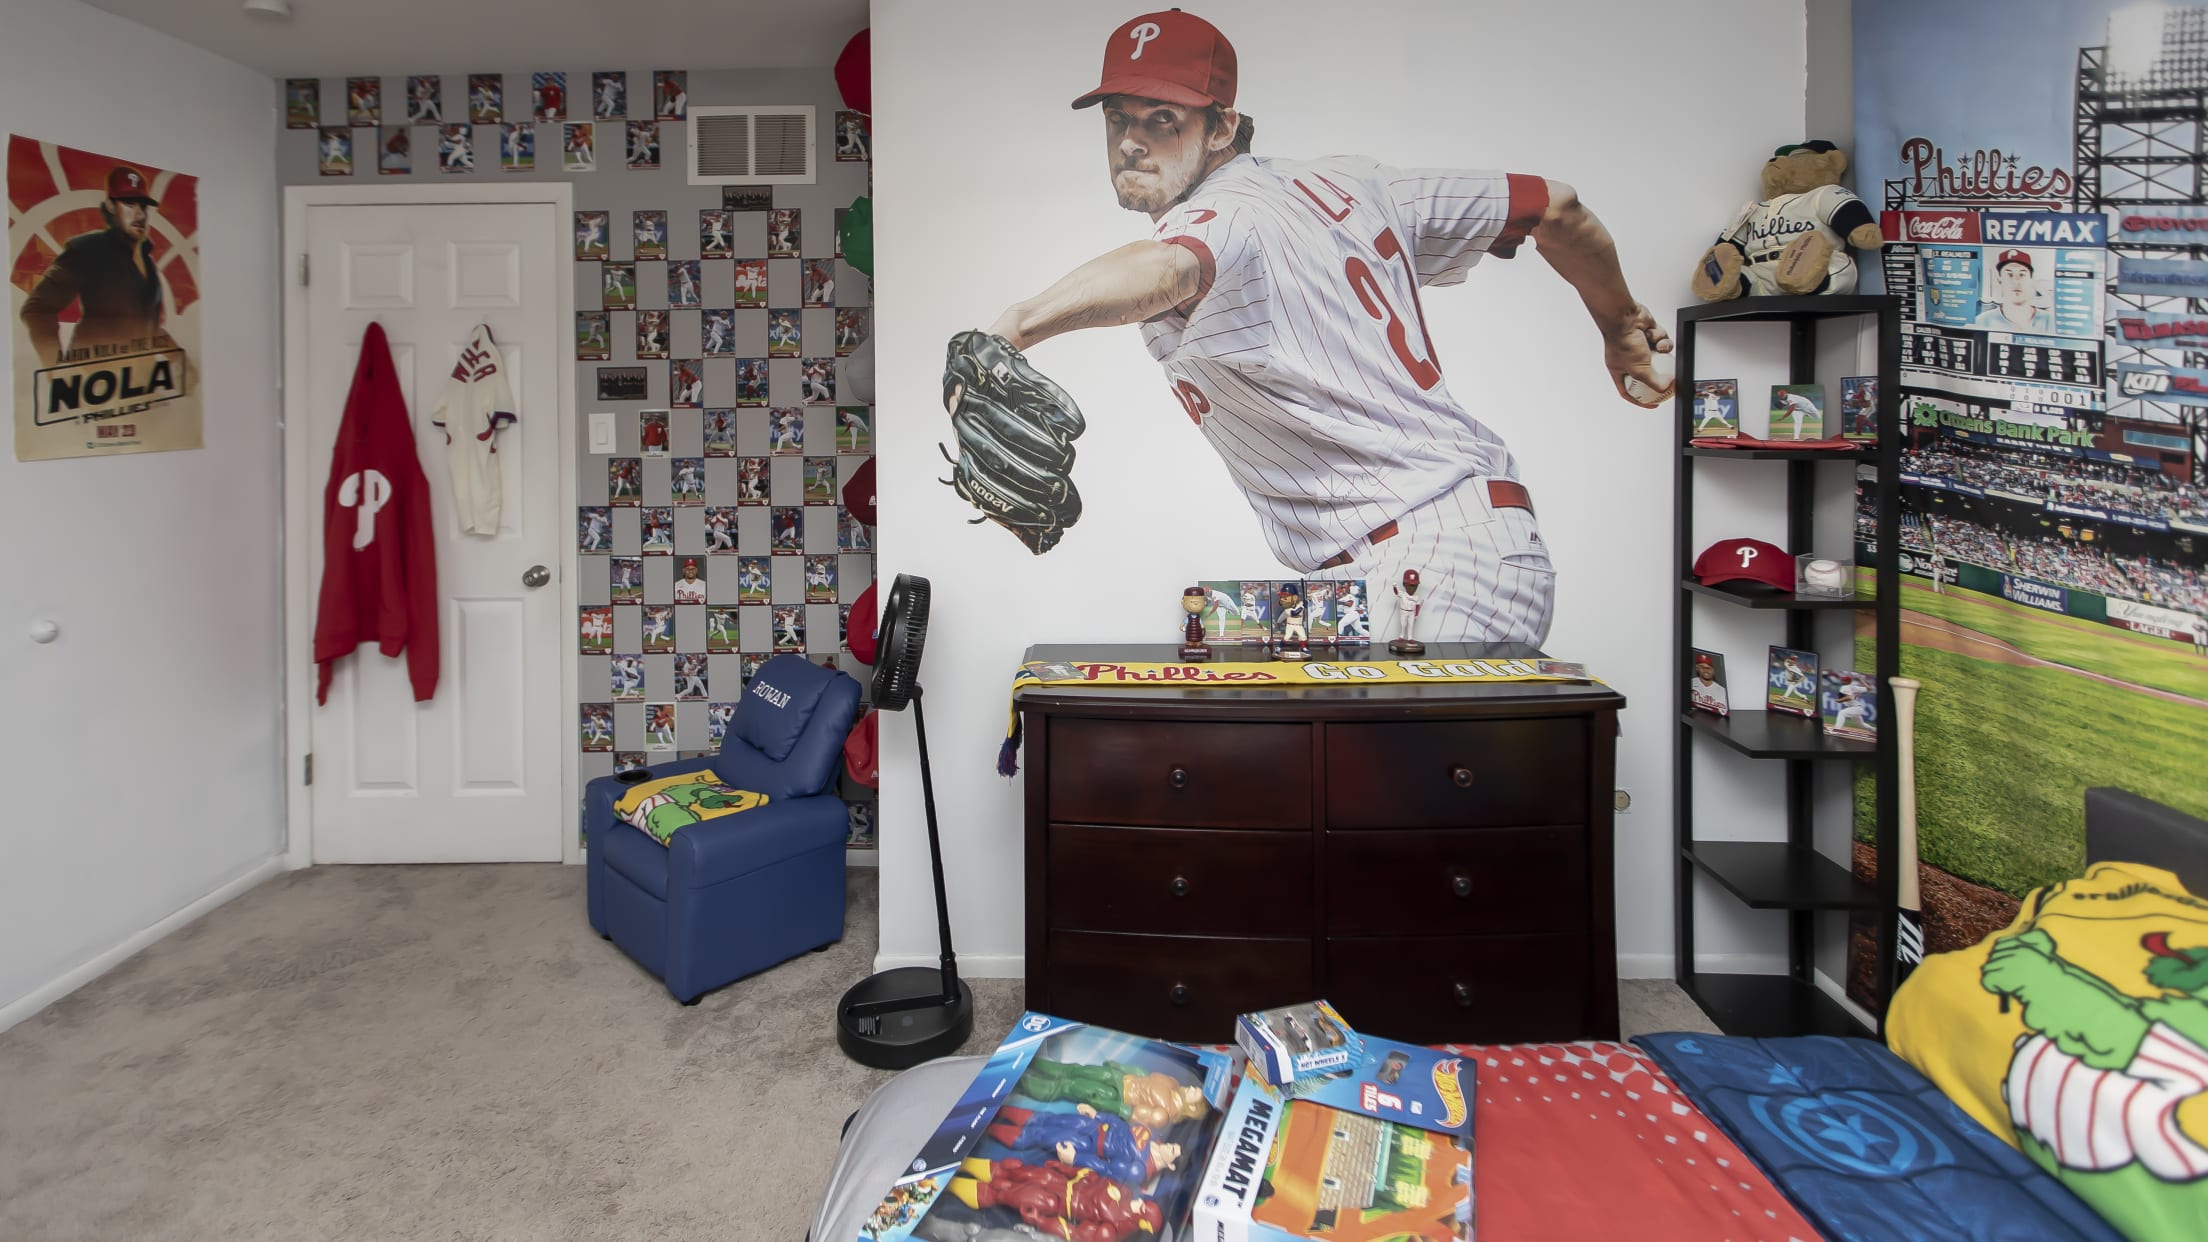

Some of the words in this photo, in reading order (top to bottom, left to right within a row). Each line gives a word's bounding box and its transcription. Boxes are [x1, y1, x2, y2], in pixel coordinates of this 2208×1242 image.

[1130, 22, 1161, 59] P
[1901, 137, 2072, 196] Phillies
[1747, 216, 1816, 241] Phillies
[1985, 219, 2096, 243] RE/MAX
[48, 360, 175, 414] NOLA
[1939, 411, 1993, 435] Citizens
[1995, 419, 2044, 441] Bank
[2047, 425, 2095, 448] Park
[338, 469, 392, 551] P
[971, 479, 1014, 513] A2000
[1736, 546, 1759, 568] P
[2013, 578, 2061, 599] SHERWIN
[2013, 589, 2064, 612] WILLIAMS
[1077, 663, 1278, 681] Phillies
[1302, 663, 1386, 680] Go
[1397, 659, 1540, 678] Gold
[752, 680, 791, 709] ROWAN
[1223, 1098, 1274, 1201] MEGAMAT
